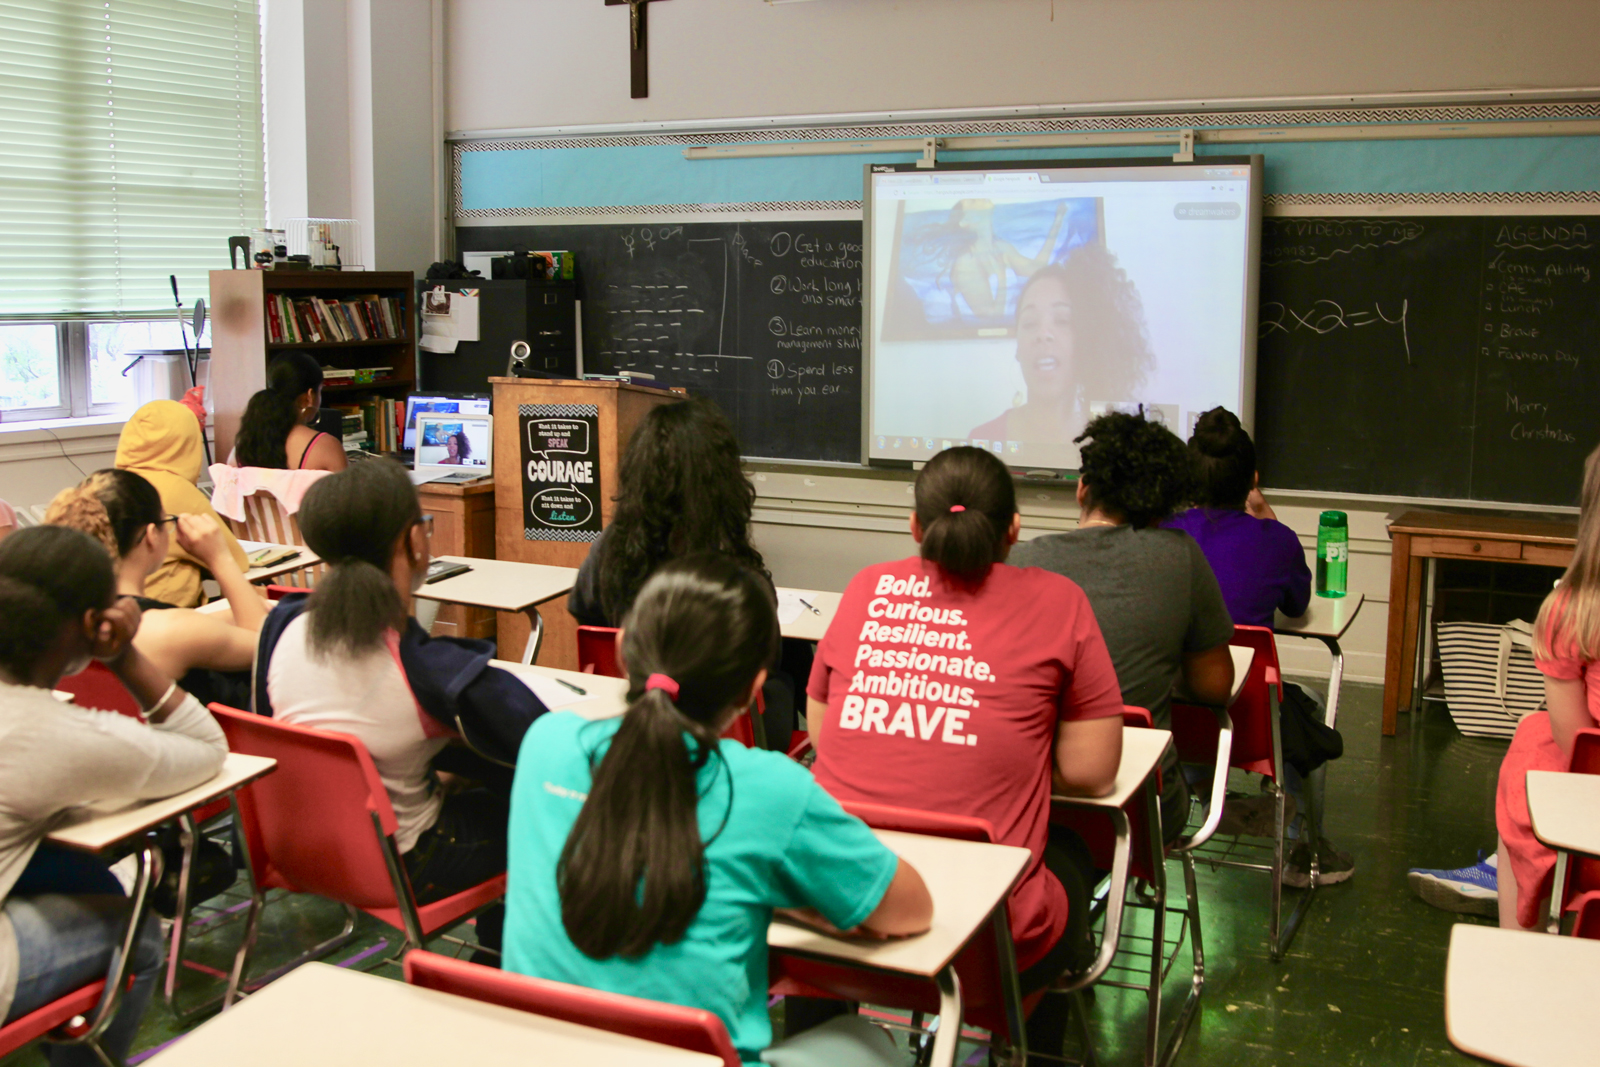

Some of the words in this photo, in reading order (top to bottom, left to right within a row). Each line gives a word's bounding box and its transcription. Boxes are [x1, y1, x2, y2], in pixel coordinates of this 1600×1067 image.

[1362, 225, 1382, 237] TO
[1393, 226, 1415, 238] ME
[1496, 223, 1588, 242] AGENDA
[794, 233, 820, 254] Get
[824, 242, 834, 252] a
[1545, 262, 1591, 283] Ability
[788, 276, 820, 292] Work
[824, 276, 852, 298] long
[801, 293, 823, 305] and
[1500, 302, 1542, 315] Lunch
[790, 321, 823, 337] Learn
[1500, 323, 1540, 338] Brave
[776, 339, 832, 354] management
[1555, 350, 1580, 369] Day
[787, 362, 825, 384] Spend
[832, 362, 855, 375] less
[769, 383, 794, 396] than
[797, 386, 817, 405] you
[1505, 391, 1549, 419] Merry
[538, 431, 553, 439] stand
[554, 432, 560, 440] up
[561, 432, 571, 440] and
[558, 424, 571, 432] takes
[572, 424, 579, 432] to
[1510, 421, 1577, 443] Christmas
[547, 438, 569, 449] SPEAK
[527, 460, 593, 483] COURAGE
[549, 510, 576, 521] listen
[550, 502, 563, 510] down
[874, 574, 933, 598] Bold.
[867, 597, 968, 626] Curious.
[859, 620, 972, 651] Resilient.
[854, 643, 996, 683] Passionate.
[848, 670, 980, 708] Ambitious.
[839, 694, 977, 746] BRAVE.
